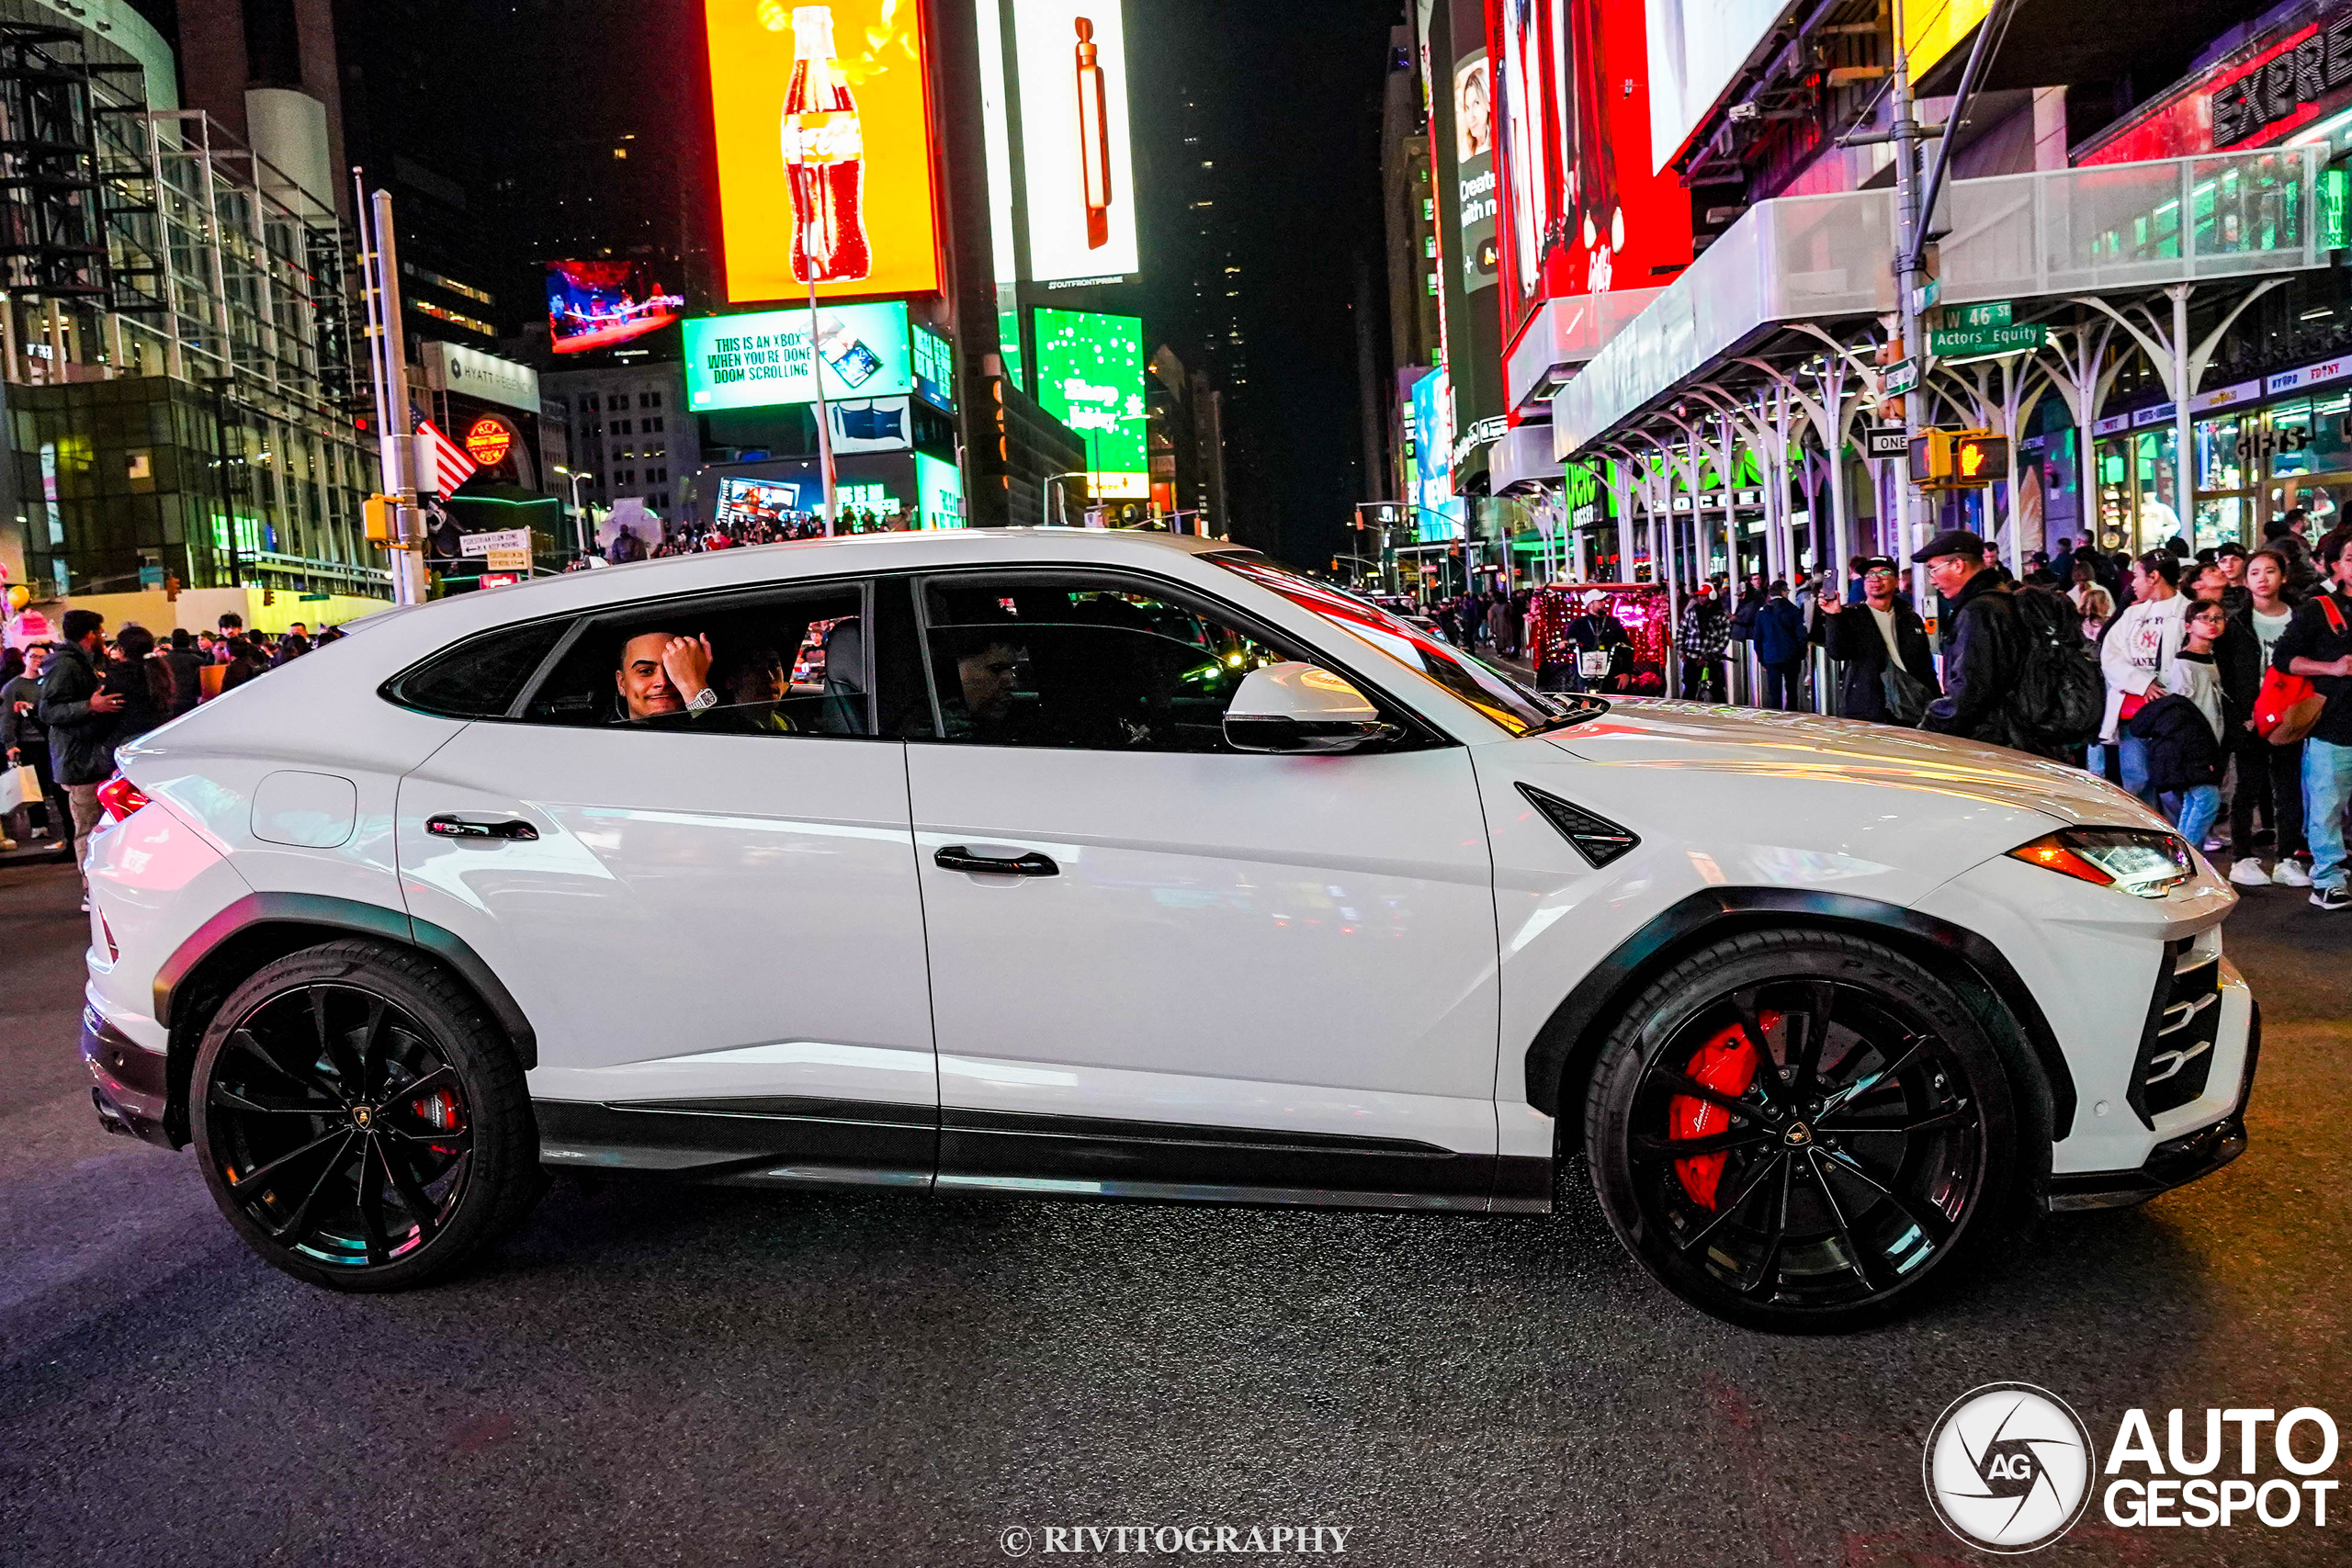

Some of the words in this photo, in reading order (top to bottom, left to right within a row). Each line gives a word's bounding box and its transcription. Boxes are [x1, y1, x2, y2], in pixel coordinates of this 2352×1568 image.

[1462, 199, 1484, 228] with
[1946, 310, 1961, 329] W
[1969, 307, 1991, 326] 46
[715, 337, 740, 353] THIS
[742, 336, 753, 350] IS
[756, 335, 771, 349] AN
[774, 333, 801, 347] XBOX
[1993, 328, 2037, 345] Equity
[707, 353, 741, 369] WHEN
[784, 346, 811, 362] DONE
[464, 366, 493, 385] HYATT
[714, 367, 745, 384] DOOM
[749, 363, 808, 381] SCROLLING
[1881, 437, 1907, 449] ONE
